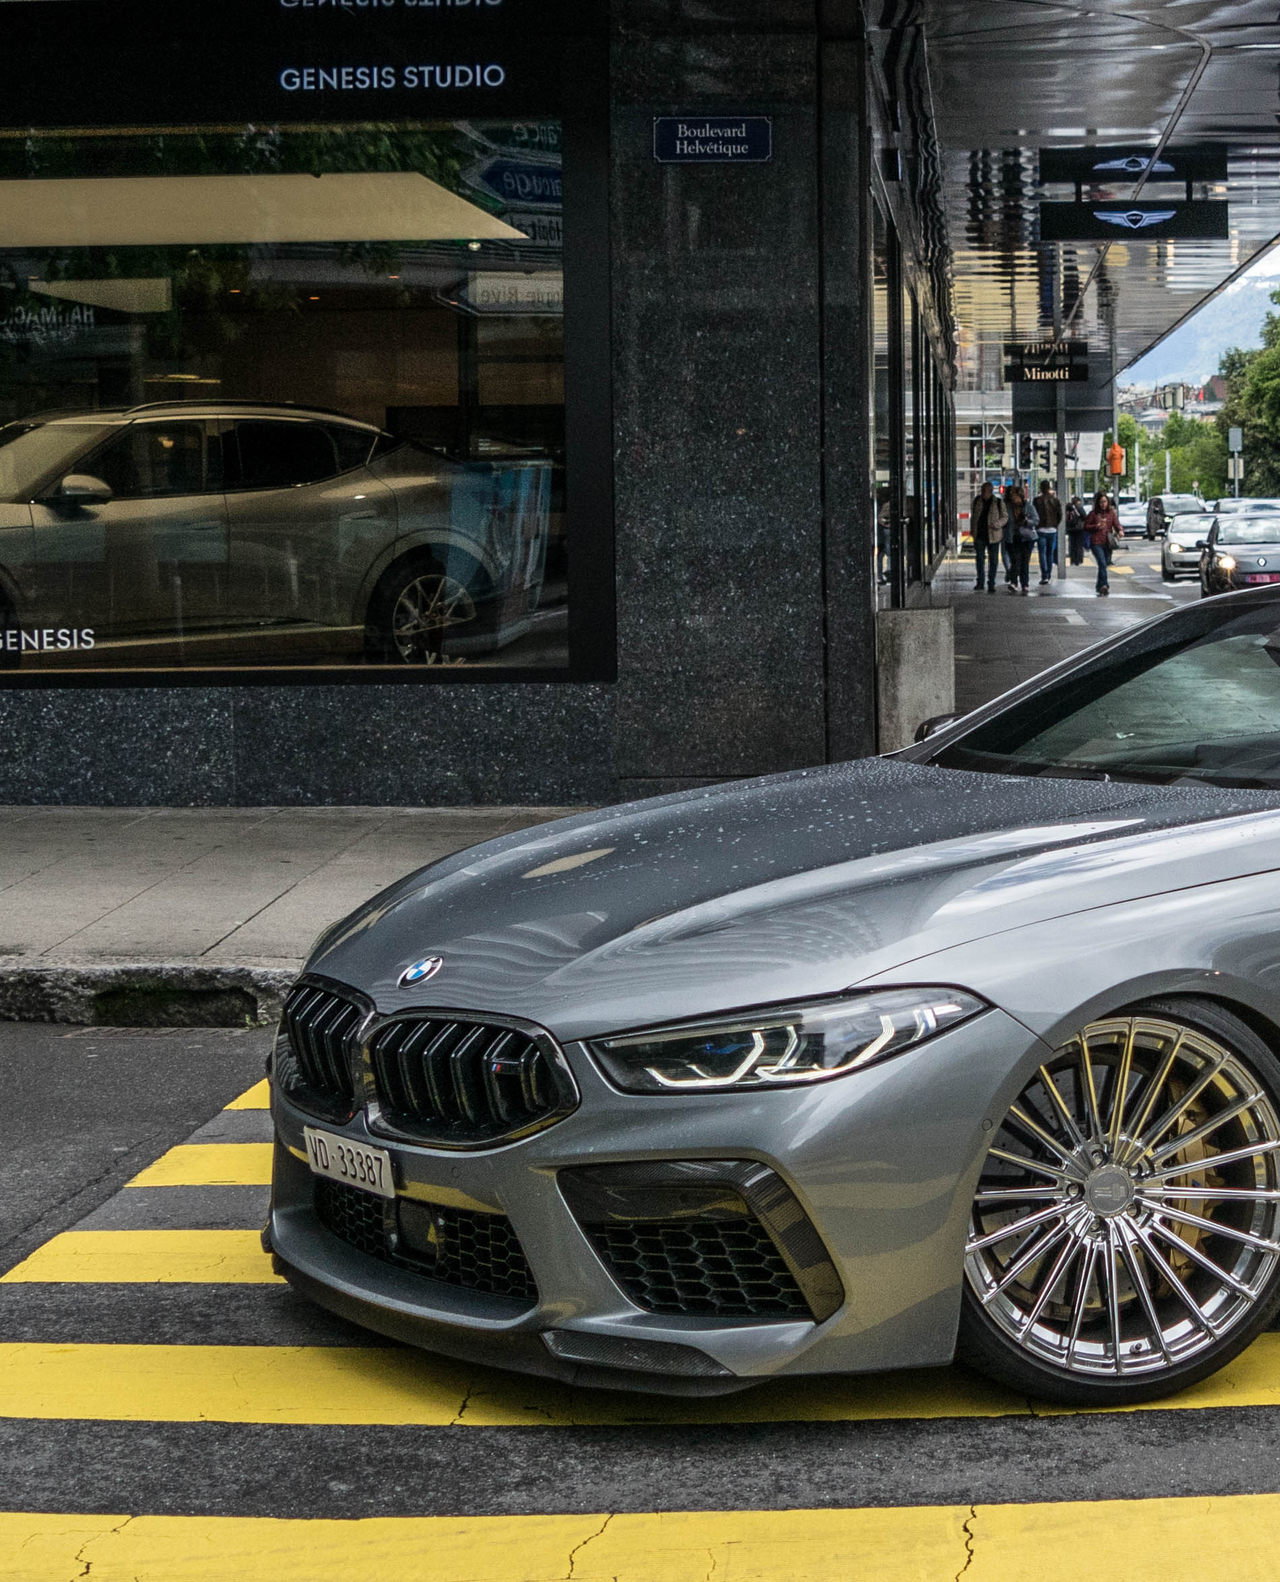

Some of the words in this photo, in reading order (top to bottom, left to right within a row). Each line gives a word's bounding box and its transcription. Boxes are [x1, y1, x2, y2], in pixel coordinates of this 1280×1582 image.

[280, 66, 396, 90] GENESIS
[403, 64, 505, 88] STUDIO
[678, 123, 746, 137] Boulevard
[675, 140, 749, 156] Helvétique
[1023, 366, 1069, 381] Minotti
[0, 628, 95, 651] ENESIS
